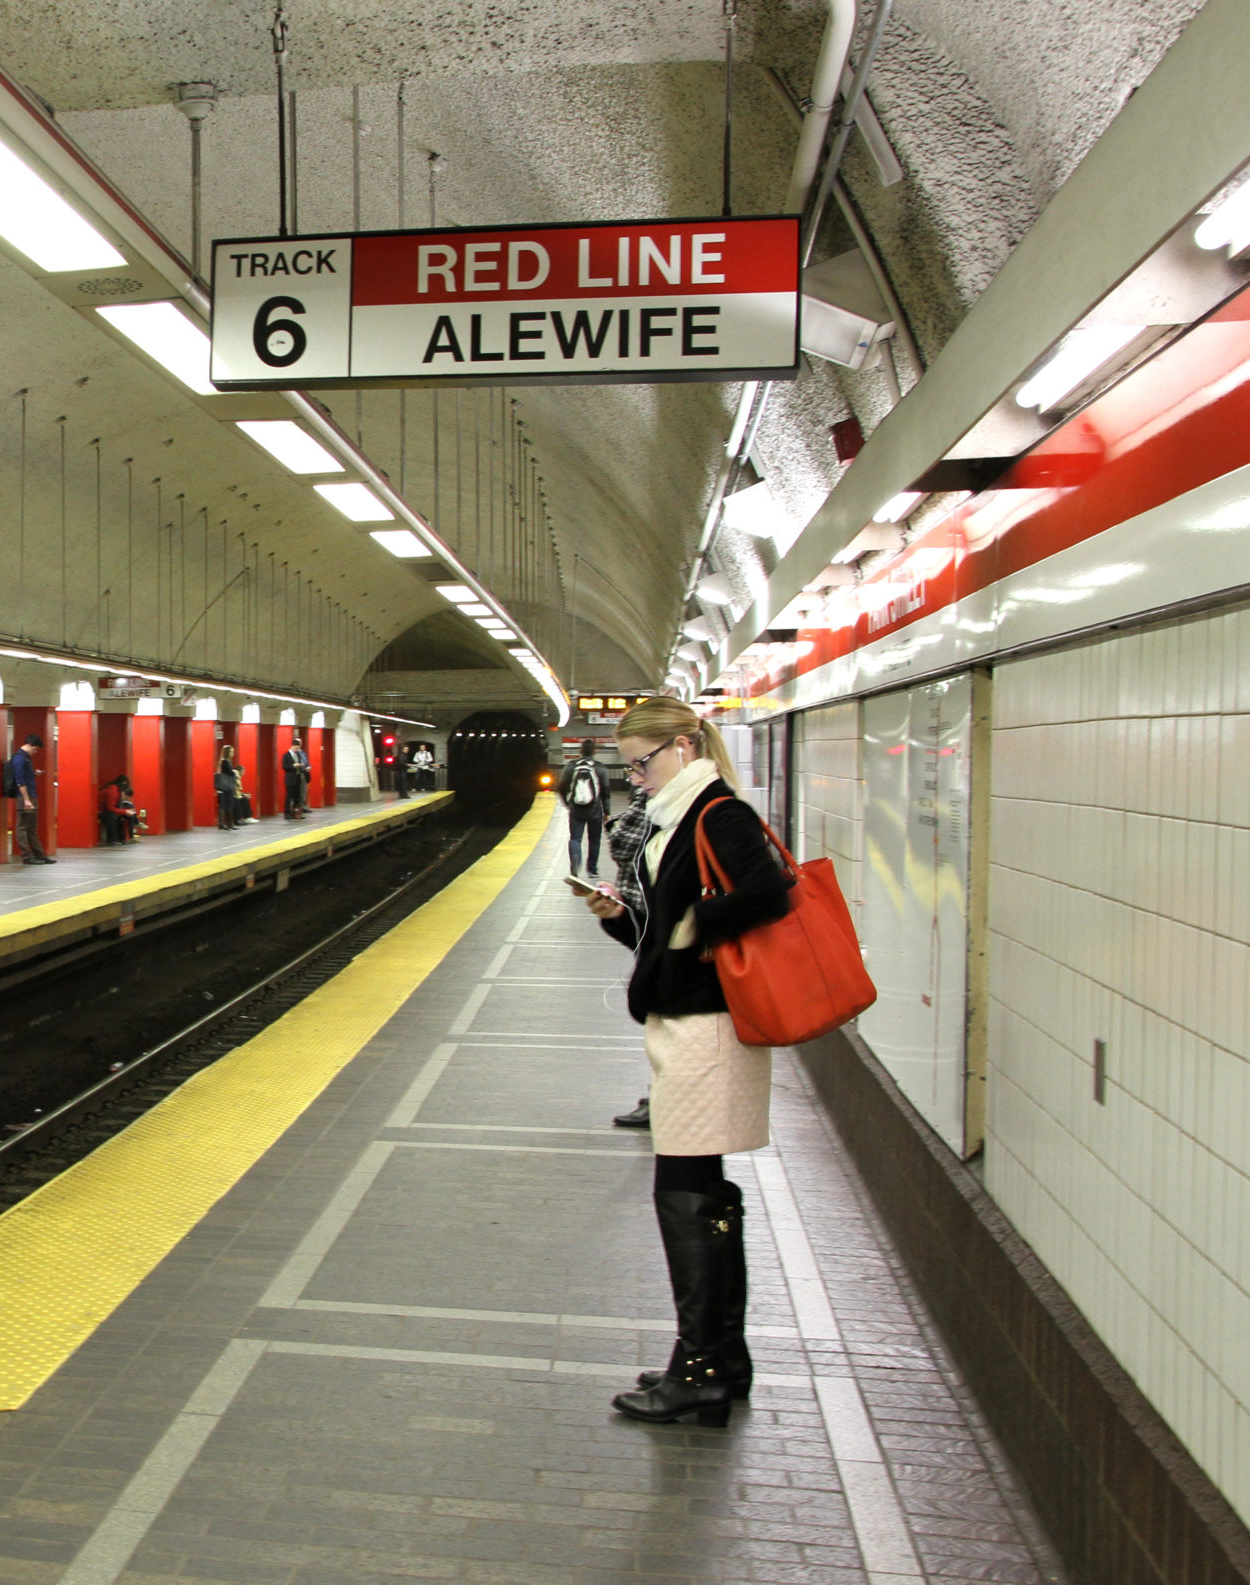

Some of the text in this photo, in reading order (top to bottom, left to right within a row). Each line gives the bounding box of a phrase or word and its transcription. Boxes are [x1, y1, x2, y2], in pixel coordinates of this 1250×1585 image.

[230, 249, 337, 278] TRACK
[417, 233, 726, 294] RED LINE
[252, 296, 307, 368] 6
[422, 306, 720, 364] ALEWIFE
[166, 685, 175, 696] 6
